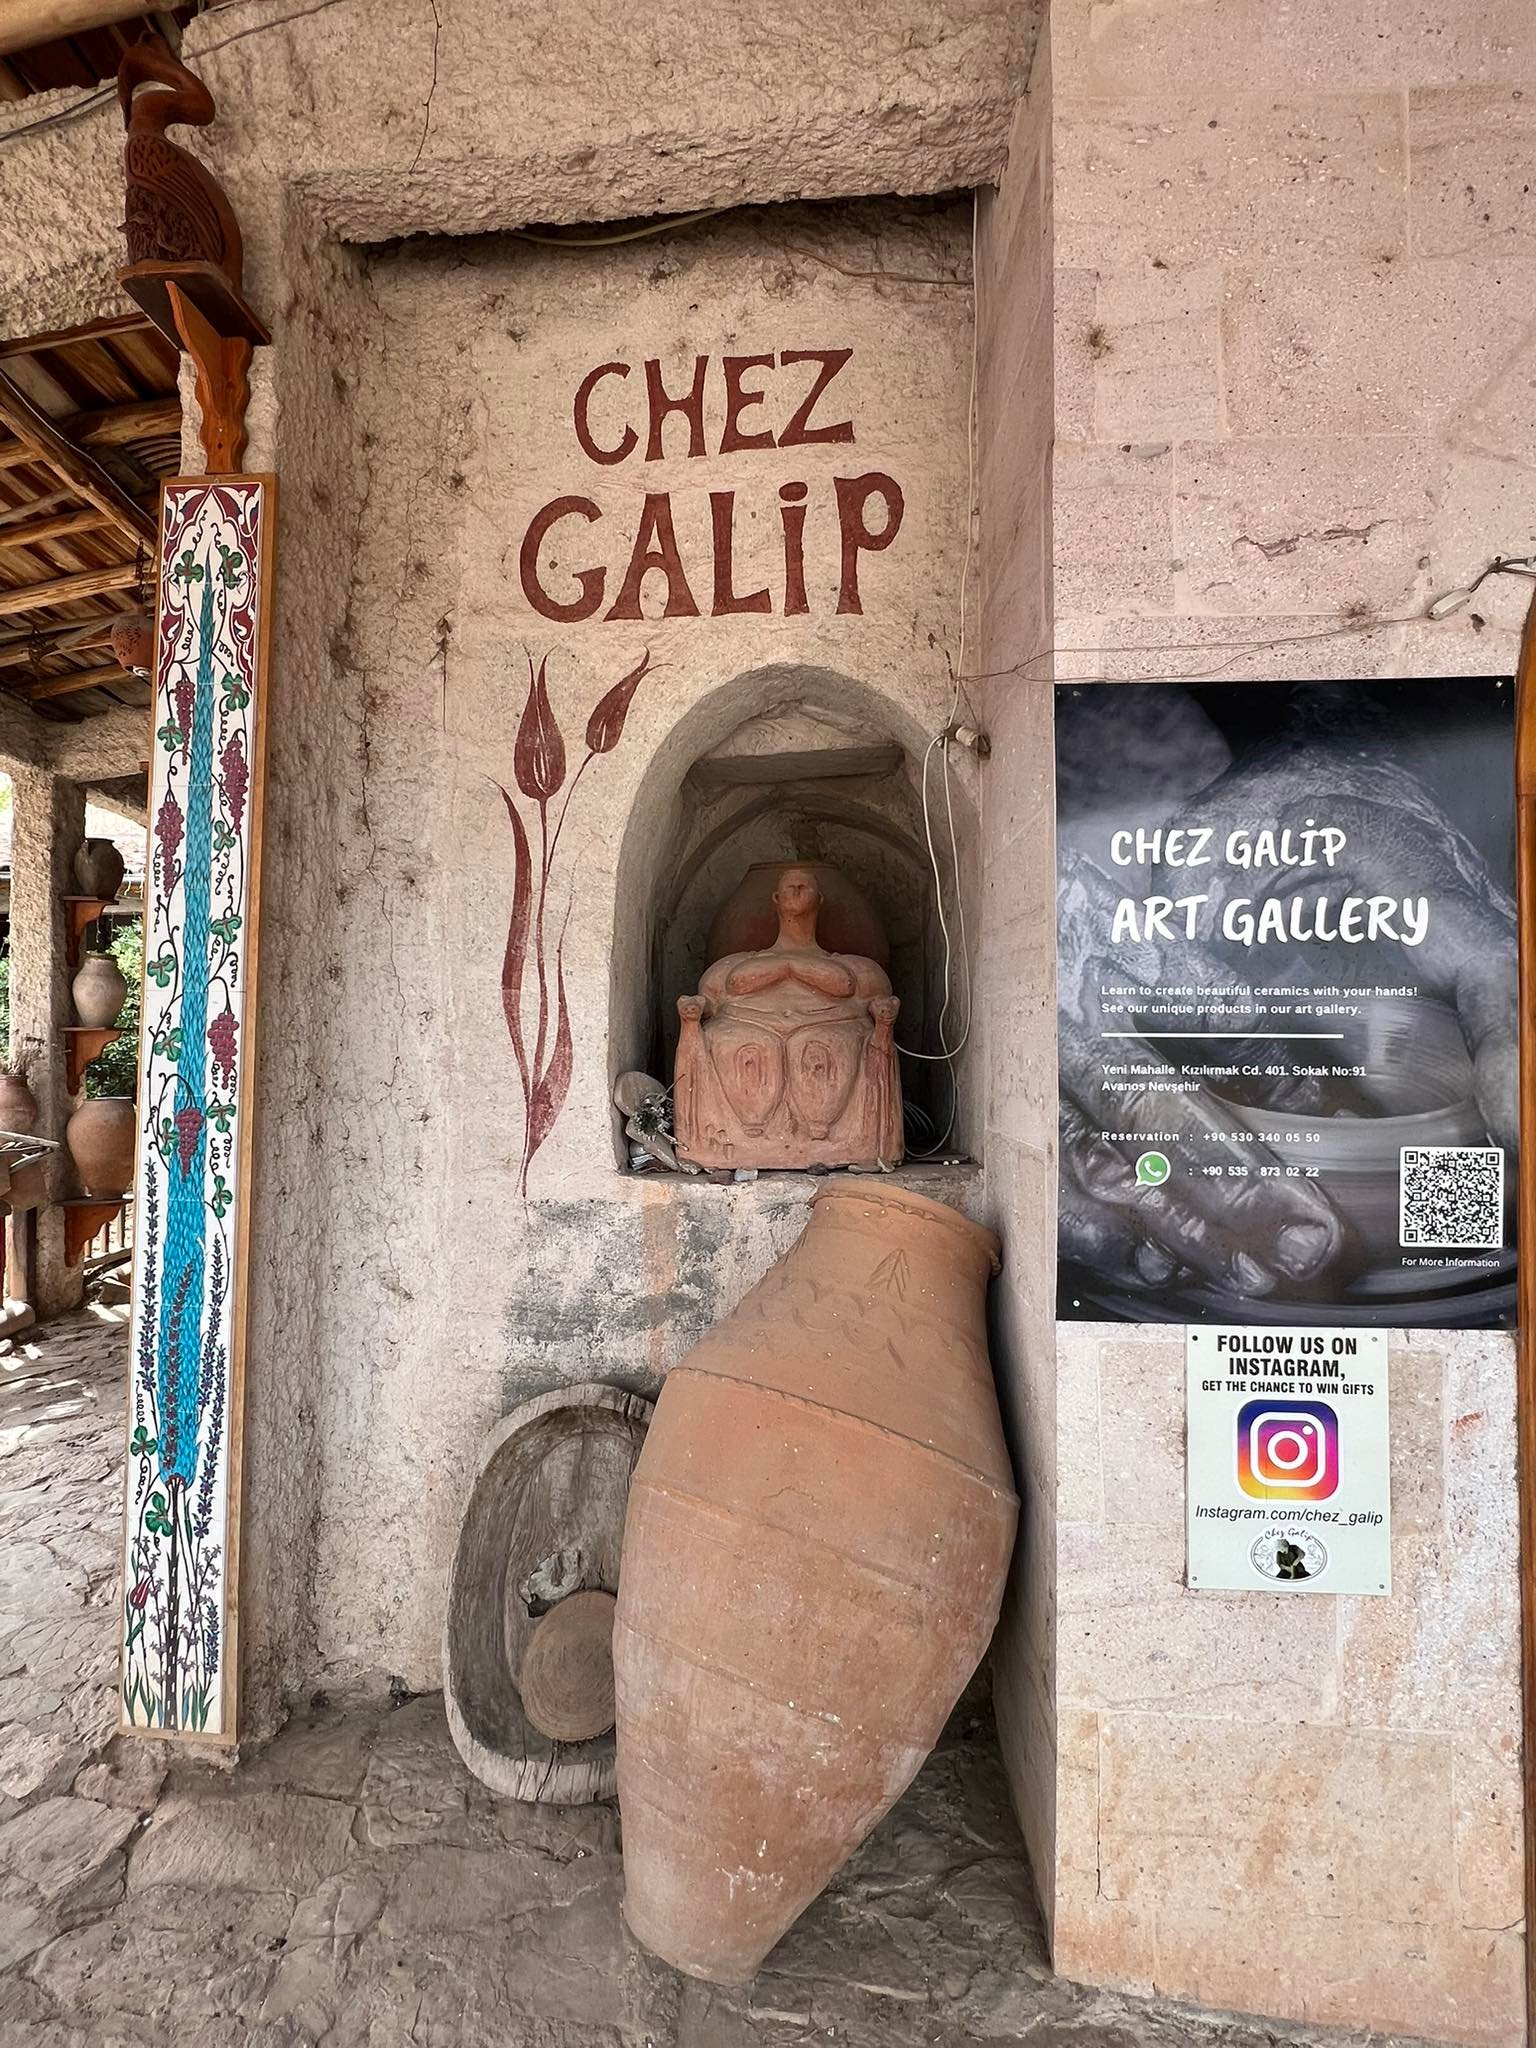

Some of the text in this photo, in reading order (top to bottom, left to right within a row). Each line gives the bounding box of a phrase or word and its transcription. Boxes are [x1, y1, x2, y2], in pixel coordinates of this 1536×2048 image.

[573, 348, 855, 465] CHEZ
[1110, 827, 1213, 867] CHEZ
[1110, 894, 1430, 947] ART GALLERY
[1101, 985, 1418, 998] Learn to create beautiful ceramics with your hands!
[1101, 1003, 1362, 1016] See our unique products in our art gallery.
[1101, 1064, 1127, 1075] Yeni
[1130, 1064, 1176, 1075] Mahalle
[1242, 1065, 1262, 1076] Cd.
[1265, 1066, 1289, 1076] 401.
[1292, 1066, 1329, 1076] Sokak
[1332, 1066, 1366, 1076] No:91
[1101, 1081, 1200, 1093] Avanos Nevşehir
[1101, 1131, 1180, 1142] Reservation
[1203, 1133, 1226, 1142] +90
[1231, 1133, 1253, 1142] 530
[1258, 1133, 1281, 1142] 340
[1285, 1133, 1300, 1142] 05
[1305, 1133, 1320, 1142] 50
[1202, 1166, 1223, 1176] +90
[1228, 1166, 1248, 1176] 535
[1260, 1167, 1281, 1177] 873
[1286, 1167, 1300, 1177] 02
[1305, 1167, 1320, 1177] 22
[1401, 1257, 1500, 1268] For More Information
[1217, 1334, 1357, 1355] FOLLOW US ON
[1229, 1357, 1346, 1381] INSTAGRAM,
[1202, 1380, 1374, 1396] GET THE CHANCE TO WIN GIFTS
[1195, 1504, 1384, 1526] Instagram.com/chez_galip
